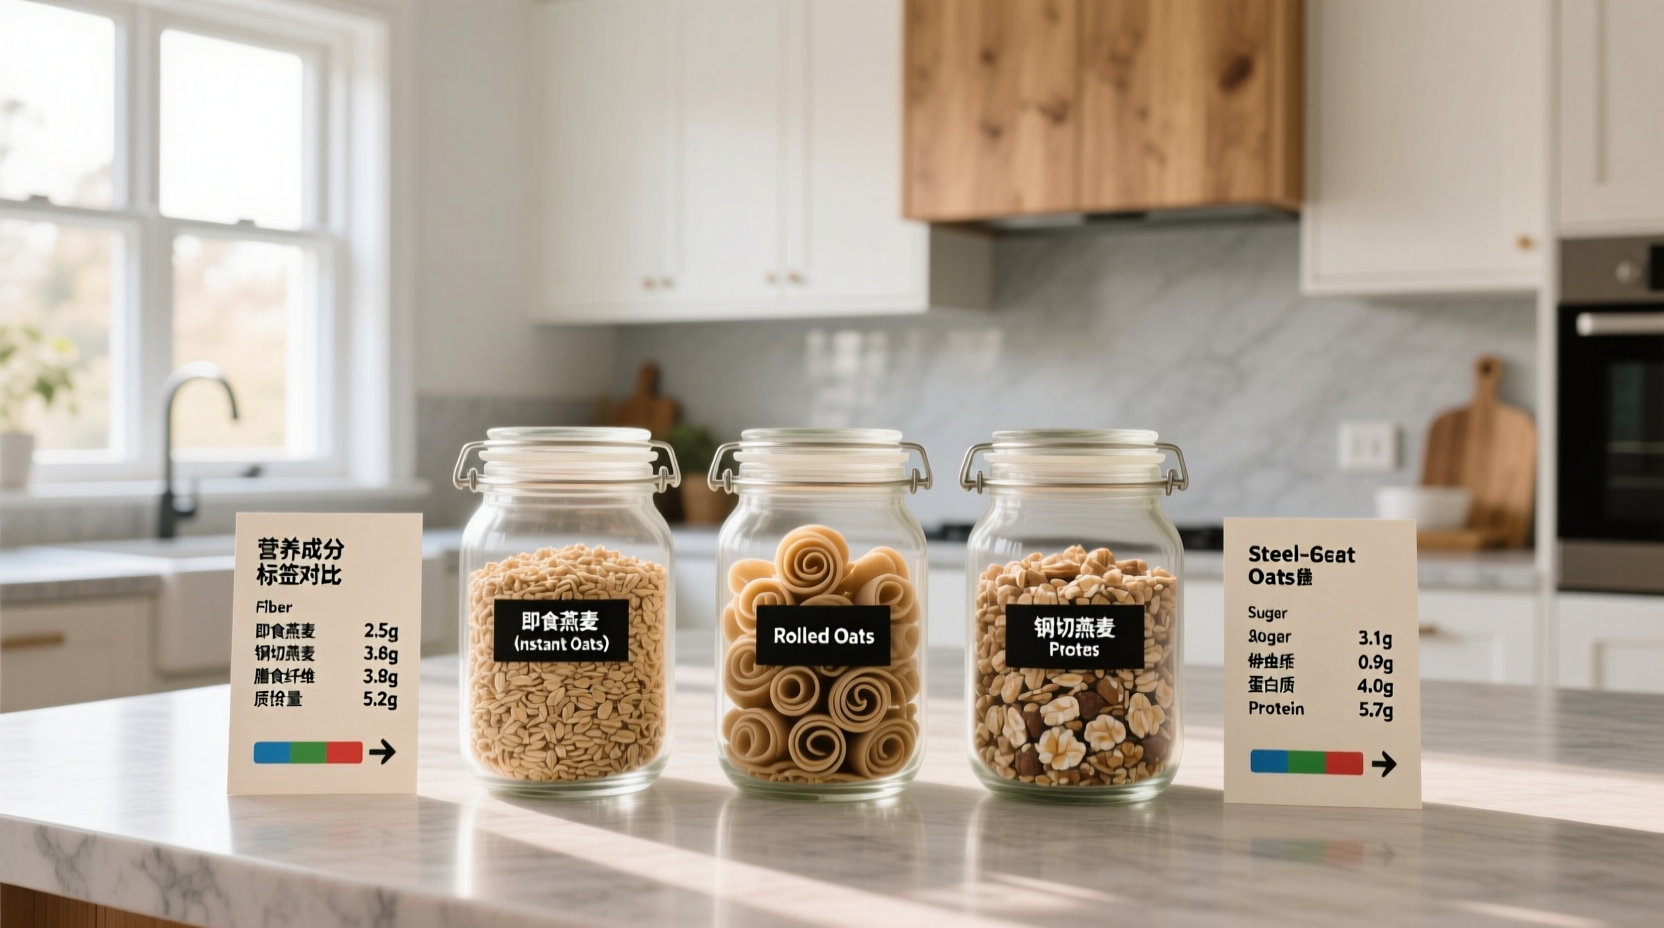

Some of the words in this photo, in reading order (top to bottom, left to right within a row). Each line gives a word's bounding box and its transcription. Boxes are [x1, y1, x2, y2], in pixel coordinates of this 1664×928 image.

[257, 536, 345, 561] 营养成分
[256, 599, 293, 614] Fiber
[521, 610, 599, 632] 即食燕麦
[255, 622, 316, 640] 即食燕麦
[364, 622, 399, 642] 2.5g
[774, 626, 830, 645] Rolled
[834, 627, 875, 645] Oats
[1358, 629, 1393, 650] 3.1g
[570, 634, 610, 653] Oats)
[1358, 654, 1394, 675] 0.9g
[363, 668, 399, 688] 3.8g
[1357, 678, 1394, 698] 4.0g
[363, 690, 398, 711] 5.2g
[1248, 700, 1305, 716] Protein
[1358, 701, 1394, 723] 5.7g
